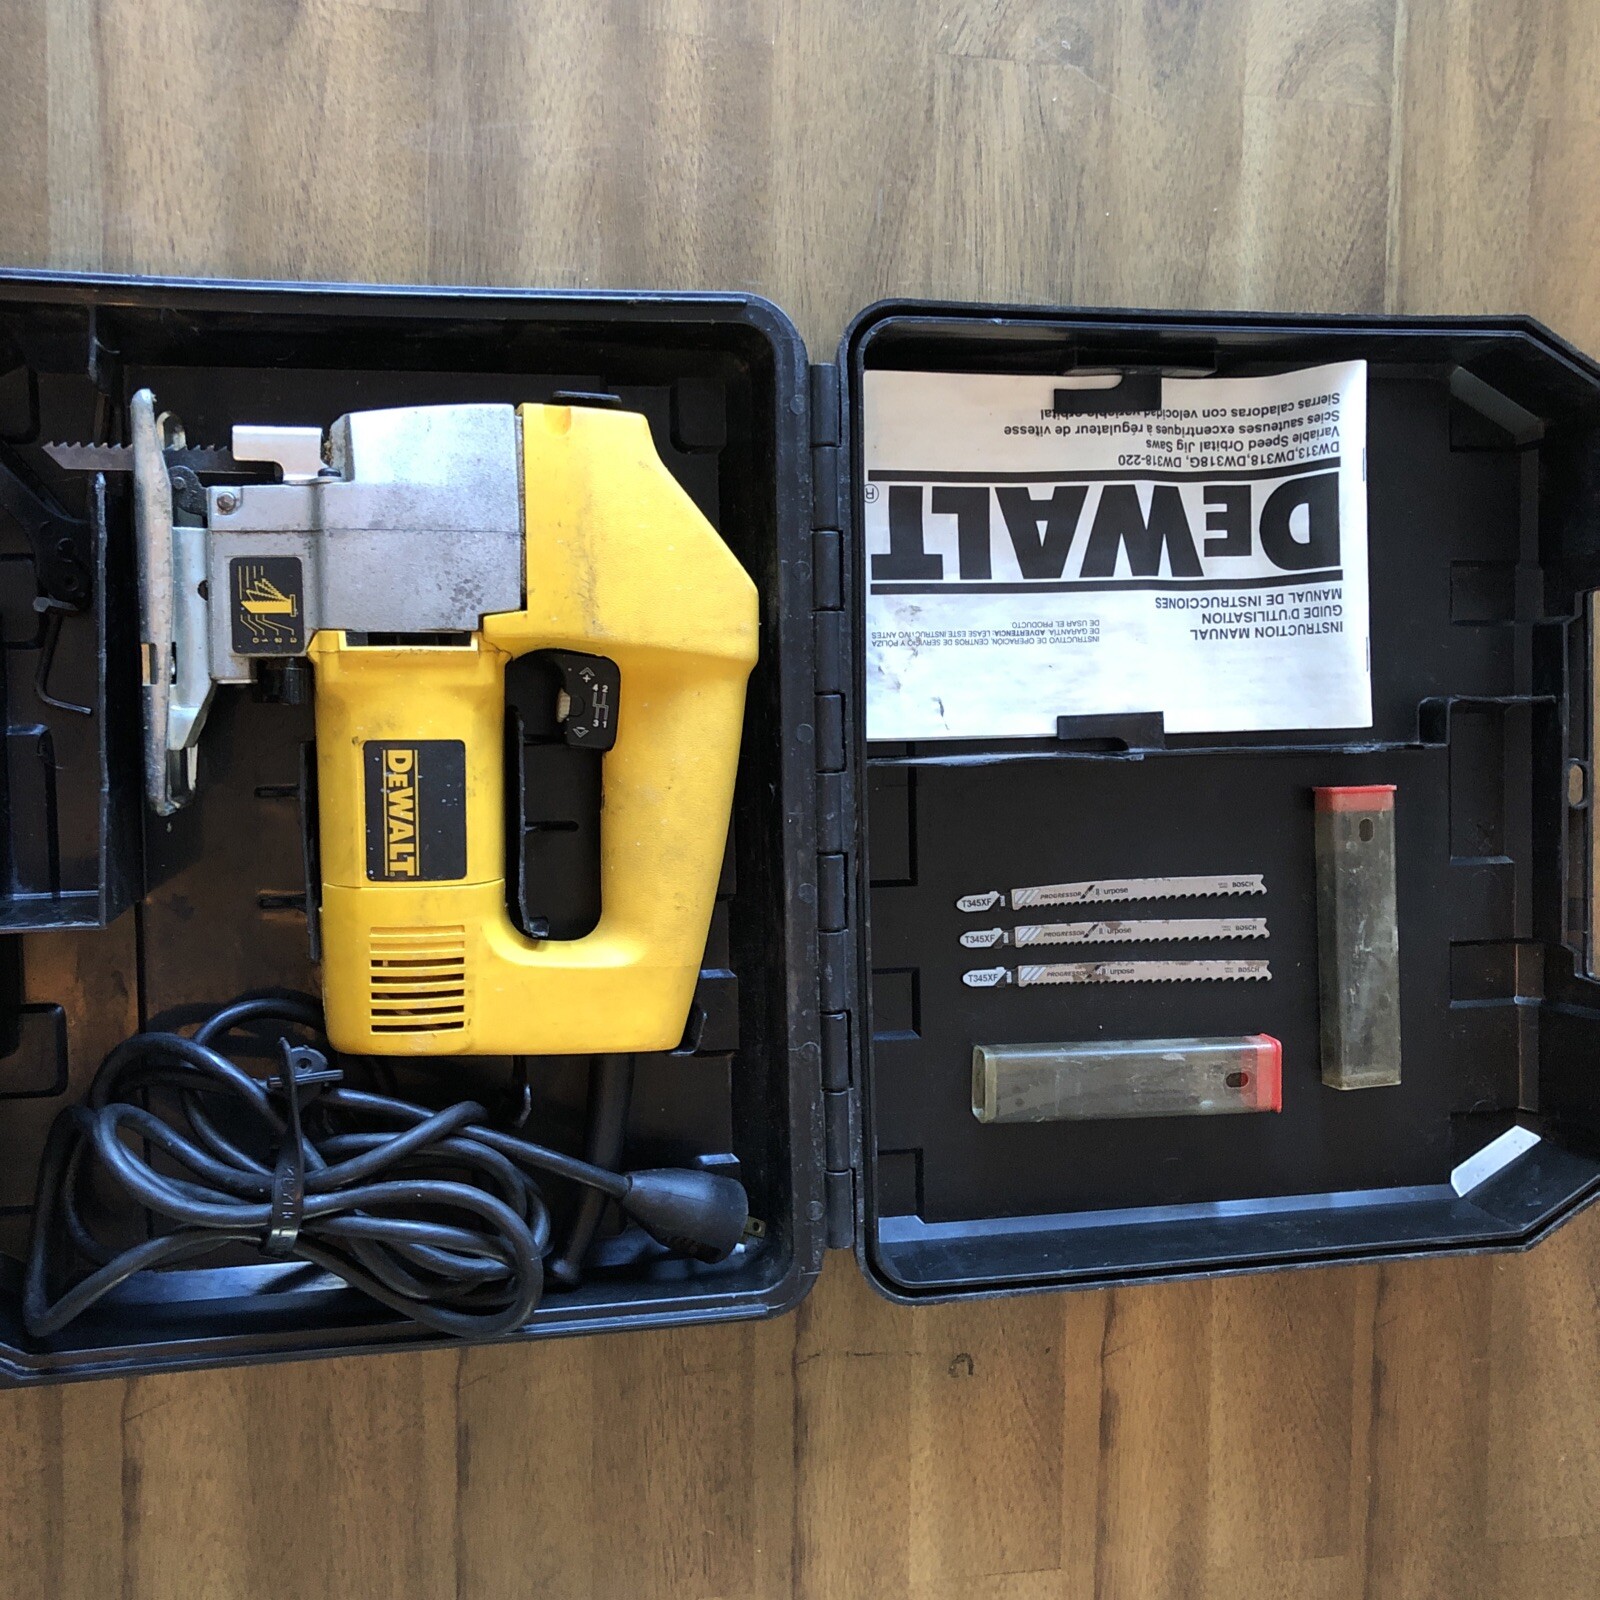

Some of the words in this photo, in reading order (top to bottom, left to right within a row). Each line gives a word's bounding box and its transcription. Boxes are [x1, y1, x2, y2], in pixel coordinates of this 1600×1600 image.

[1298, 392, 1340, 411] Sierras
[1144, 409, 1198, 421] velocidad
[1202, 409, 1227, 419] con
[1231, 402, 1295, 418] caladoras
[1307, 410, 1340, 425] Scies
[1004, 426, 1051, 437] vitesse
[1055, 425, 1071, 437] de
[1075, 421, 1144, 436] régulateur
[1146, 424, 1153, 436] à
[1156, 424, 1235, 438] excentriques
[1239, 418, 1304, 435] sauteuses
[1292, 426, 1340, 444] Variable
[1146, 439, 1173, 453] Saws
[1177, 439, 1195, 453] Jig
[1200, 440, 1244, 454] Orbital
[1249, 434, 1289, 451] Speed
[1118, 454, 1181, 468] DW318-220
[871, 472, 1340, 580] DEWALT
[1155, 595, 1261, 609] INSTRUCCIONES
[1266, 593, 1284, 605] DE
[1288, 588, 1342, 603] MANUAL
[1202, 608, 1300, 624] D'UTILISATION
[1304, 605, 1343, 618] GUIDE
[871, 631, 896, 639] ANTES
[948, 630, 966, 638] ESTE
[968, 630, 990, 638] LÉASE
[992, 629, 1045, 637] ADVERTENCIA:
[1190, 628, 1250, 640] MANUAL
[1255, 621, 1343, 638] INSTRUCTION
[871, 640, 899, 648] PÓLIZA
[954, 638, 989, 646] CENTROS
[592, 683, 599, 692] 4
[602, 685, 609, 693] 2
[593, 719, 599, 727] 3
[602, 720, 608, 729] 1
[387, 749, 415, 876] DEWALT
[962, 898, 993, 908] T345XF
[1040, 891, 1081, 900] PROGRESSOR
[965, 934, 995, 944] T345XF
[968, 974, 999, 983] T345XF
